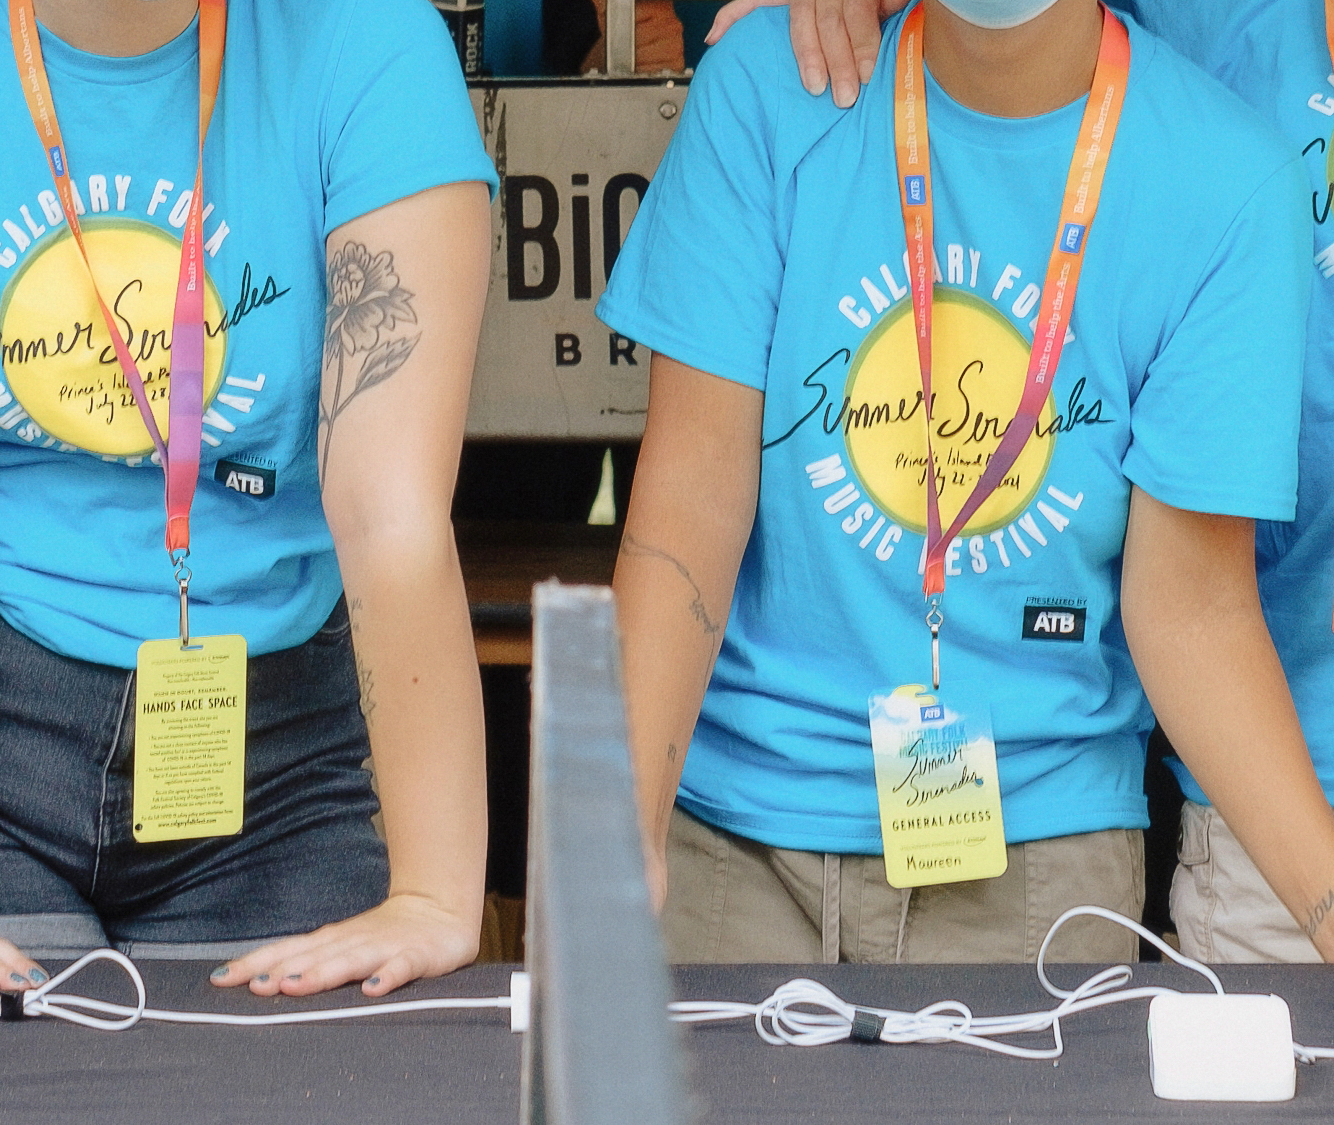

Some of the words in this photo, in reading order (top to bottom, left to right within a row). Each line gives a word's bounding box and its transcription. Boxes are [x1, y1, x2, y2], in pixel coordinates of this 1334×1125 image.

[52, 150, 64, 172] ATB
[910, 178, 921, 201] ATB
[1065, 226, 1080, 249] ATB
[99, 262, 292, 365] Sernades
[992, 263, 1075, 346] FO
[762, 348, 936, 450] Summer
[936, 360, 1116, 445] Sernades
[225, 470, 264, 495] ATB
[805, 453, 903, 562] MUSIC
[1033, 611, 1075, 634] ATB
[143, 701, 176, 715] HANDS
[180, 698, 204, 711] FACE
[208, 695, 238, 709] SPACE
[892, 815, 945, 832] GENERAL
[948, 810, 992, 827] ACCESS
[906, 854, 962, 872] Maureen
